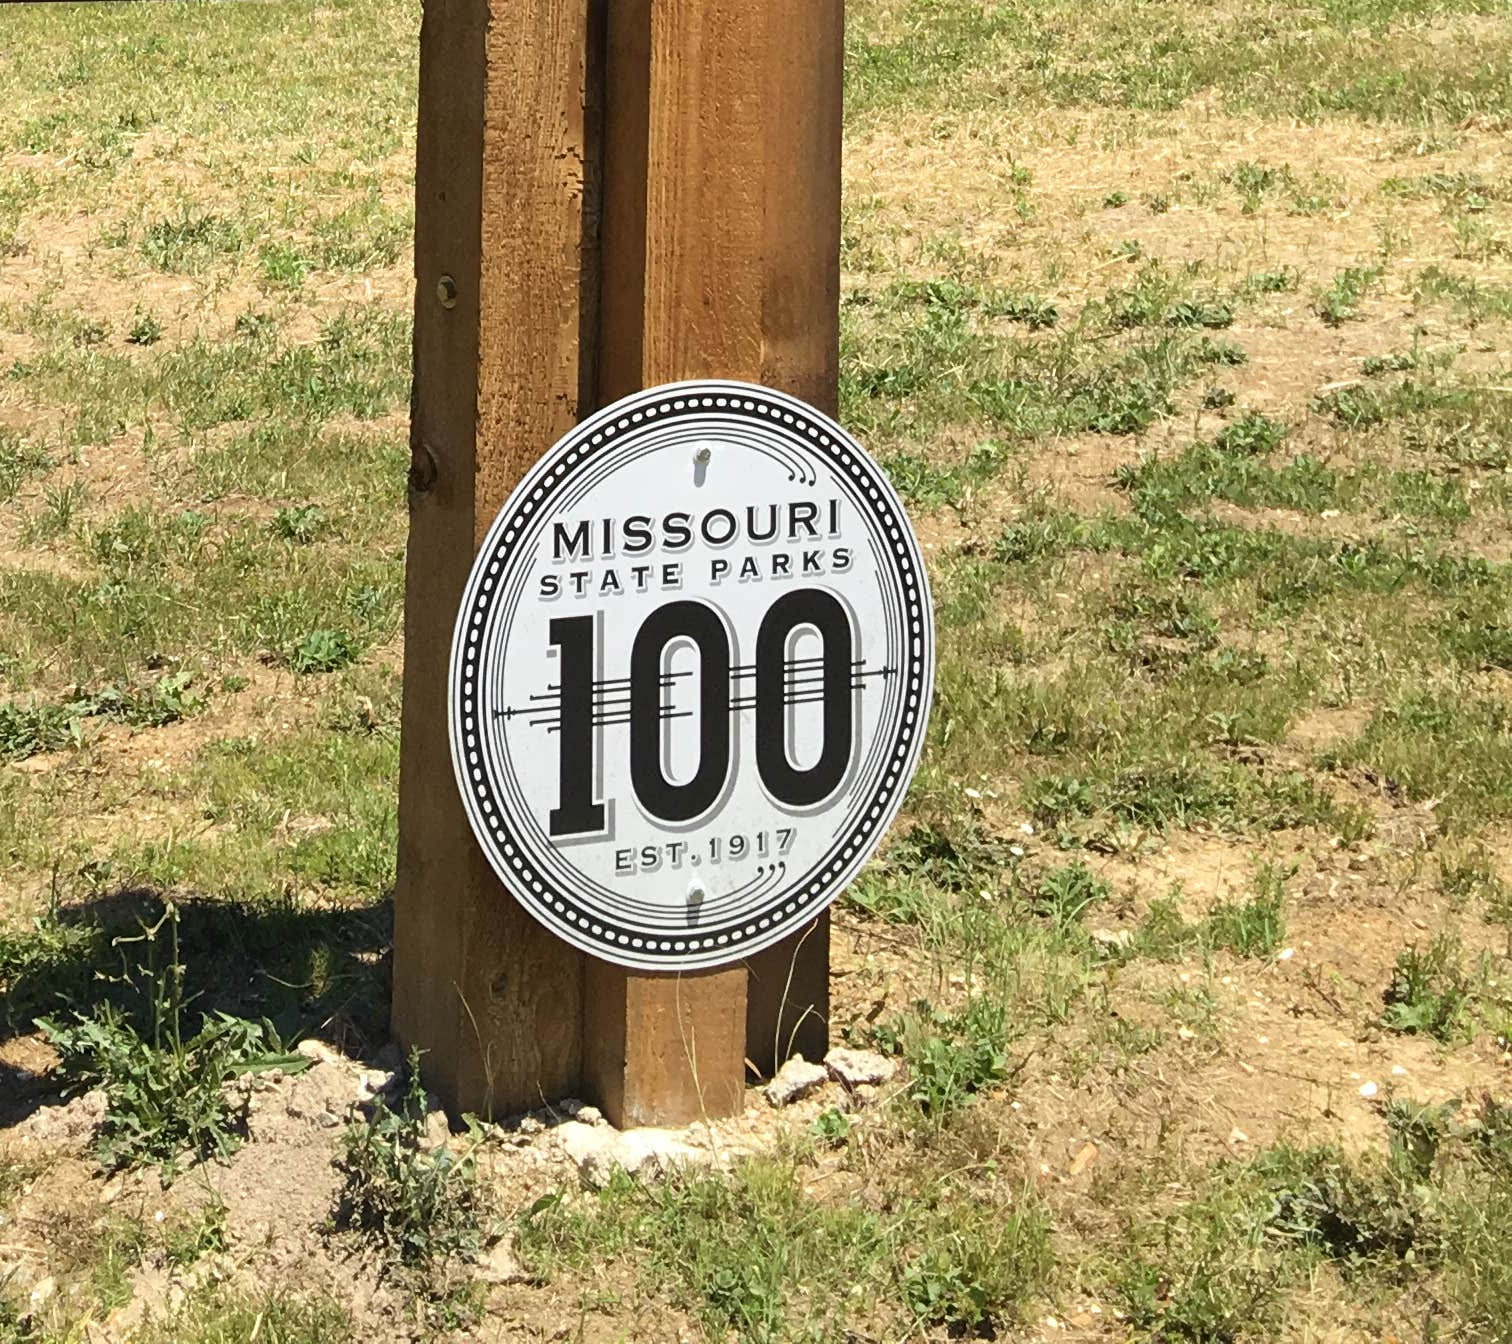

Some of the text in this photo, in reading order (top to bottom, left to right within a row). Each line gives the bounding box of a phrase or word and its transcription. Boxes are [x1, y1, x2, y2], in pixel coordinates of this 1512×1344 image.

[552, 498, 843, 559] MISSOURI
[539, 547, 853, 598] STATE PARKS
[548, 587, 857, 839] 100
